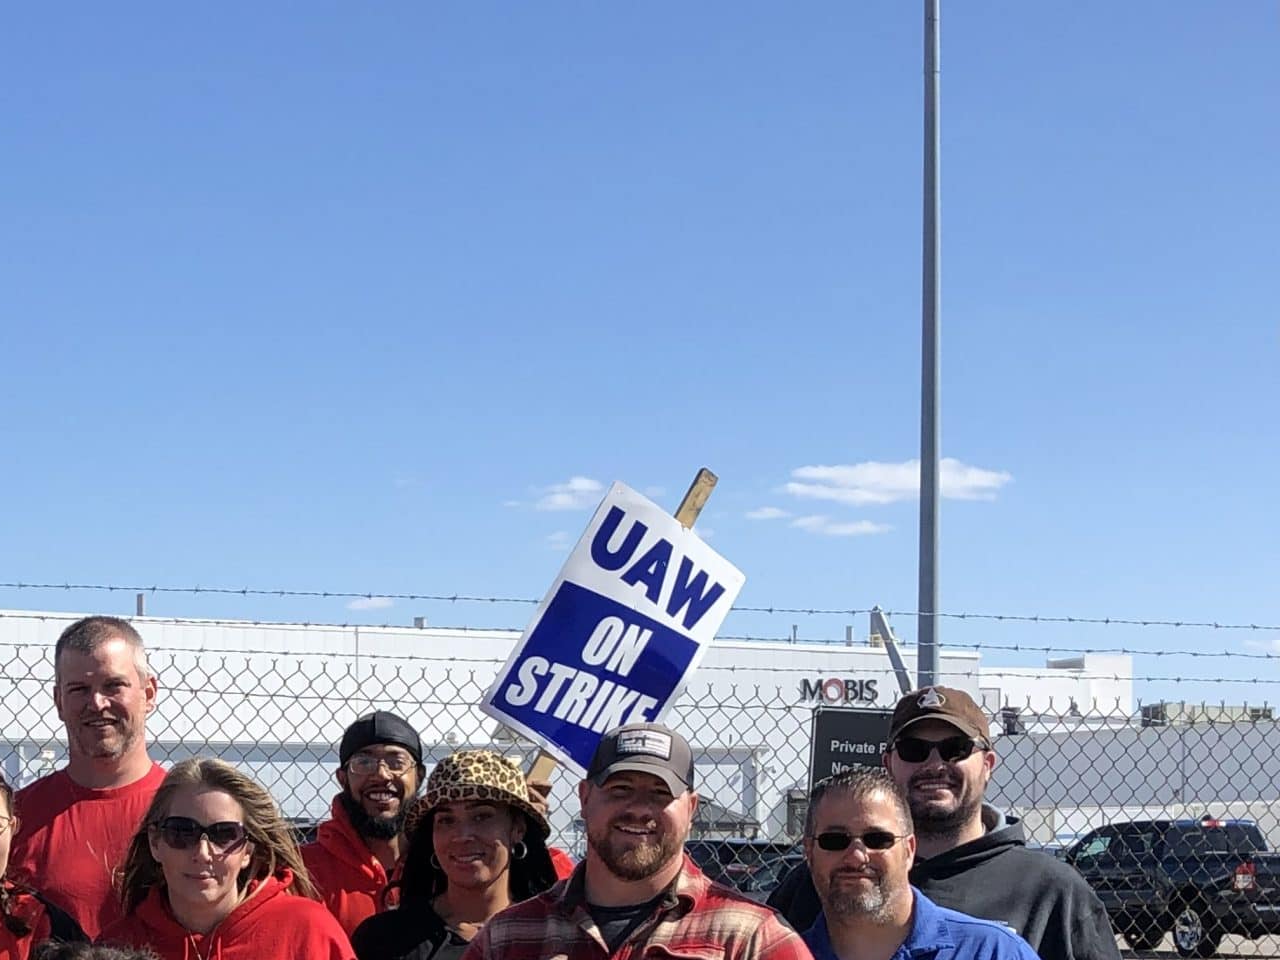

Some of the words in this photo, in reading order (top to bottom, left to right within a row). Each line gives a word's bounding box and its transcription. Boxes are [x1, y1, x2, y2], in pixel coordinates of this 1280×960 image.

[590, 505, 726, 631] UAW
[581, 616, 653, 677] ON
[505, 656, 659, 733] STRIKE
[801, 678, 879, 704] MOBIS
[831, 740, 876, 754] Private
